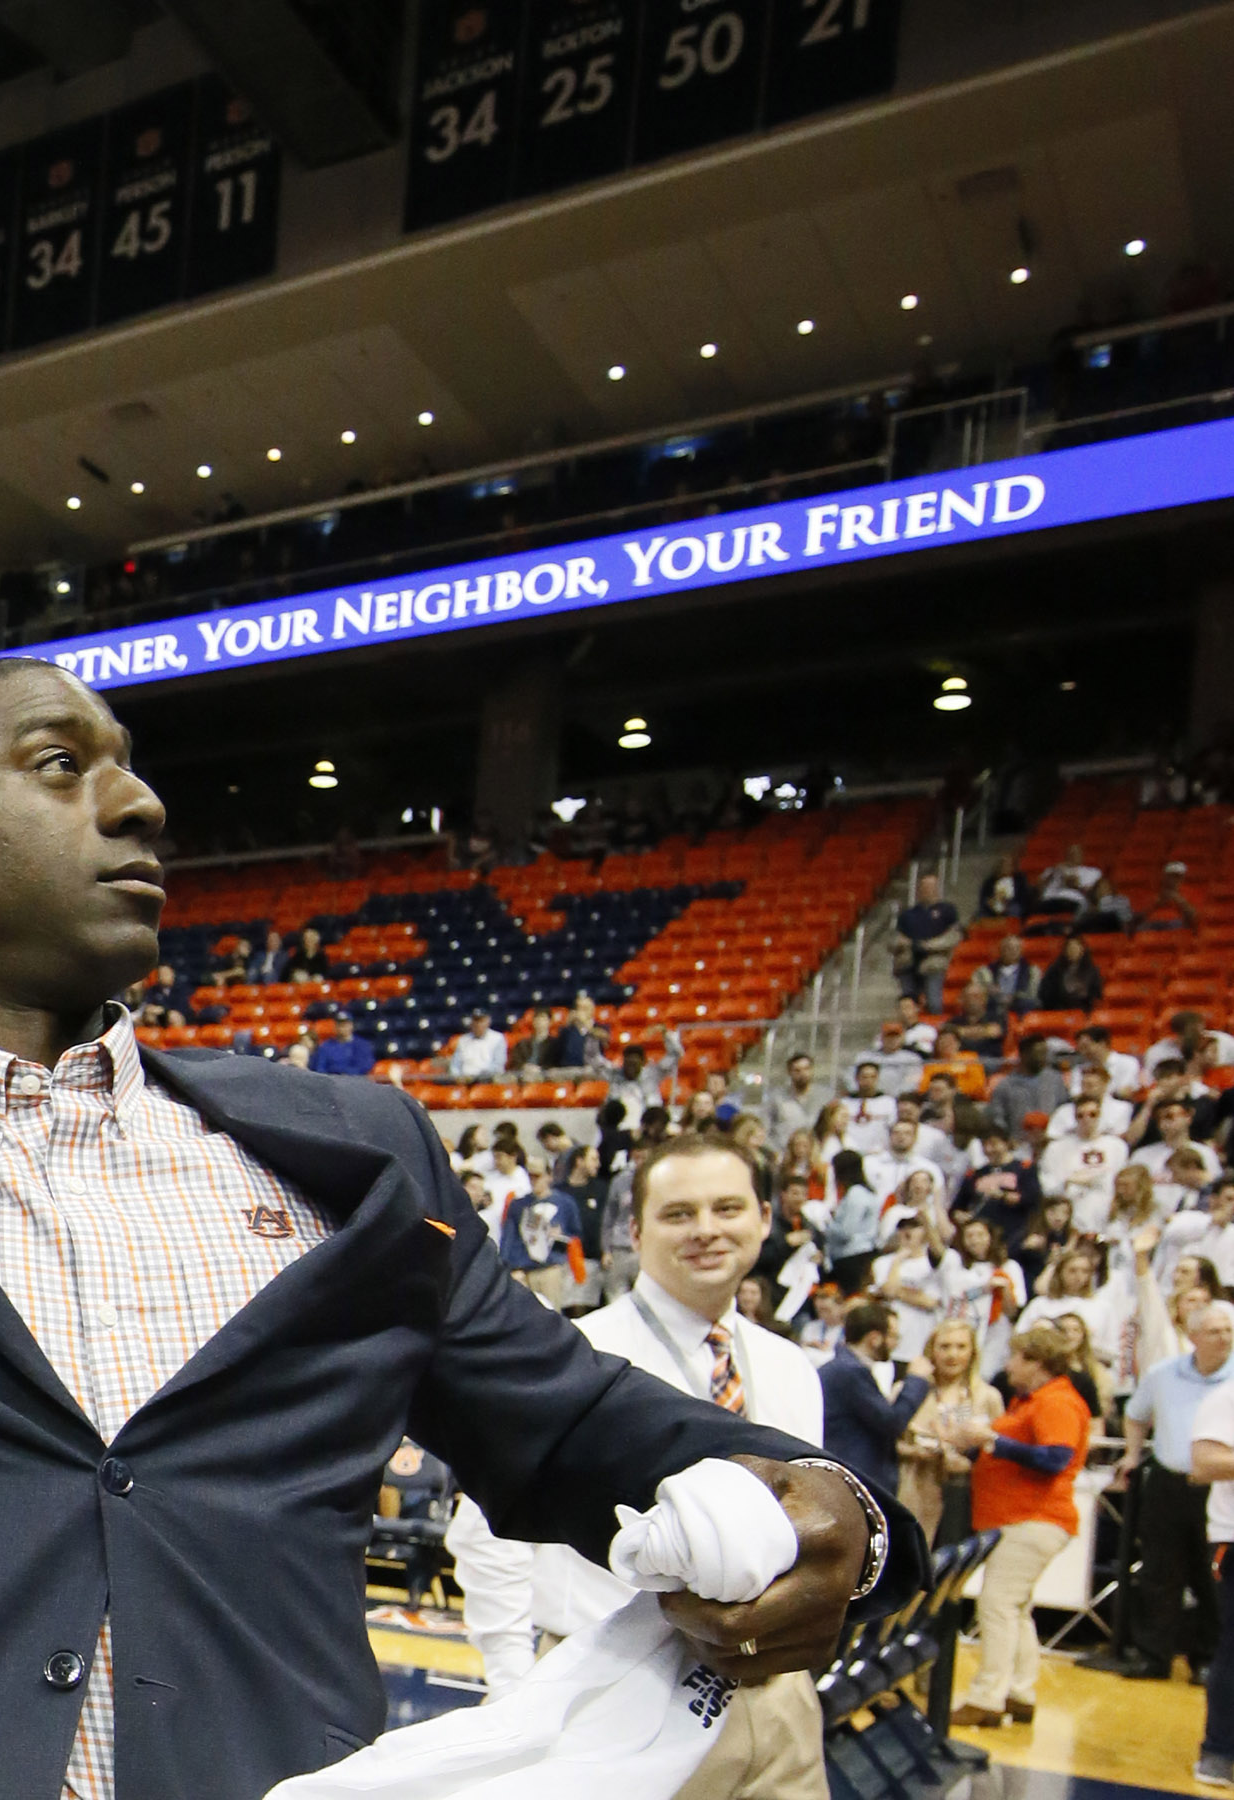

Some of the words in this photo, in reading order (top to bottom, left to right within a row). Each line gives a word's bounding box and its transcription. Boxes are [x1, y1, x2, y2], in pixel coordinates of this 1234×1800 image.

[422, 50, 514, 100] JACKSON
[659, 10, 746, 90] 50
[541, 52, 615, 128] 25
[423, 88, 500, 163] 34
[111, 200, 173, 260] 45
[215, 168, 258, 232] 11
[26, 229, 84, 291] 34
[198, 607, 323, 663] YOUR
[331, 556, 610, 641] NEIGHBOR,
[623, 523, 790, 587] YOUR
[802, 474, 1046, 557] FRIEND
